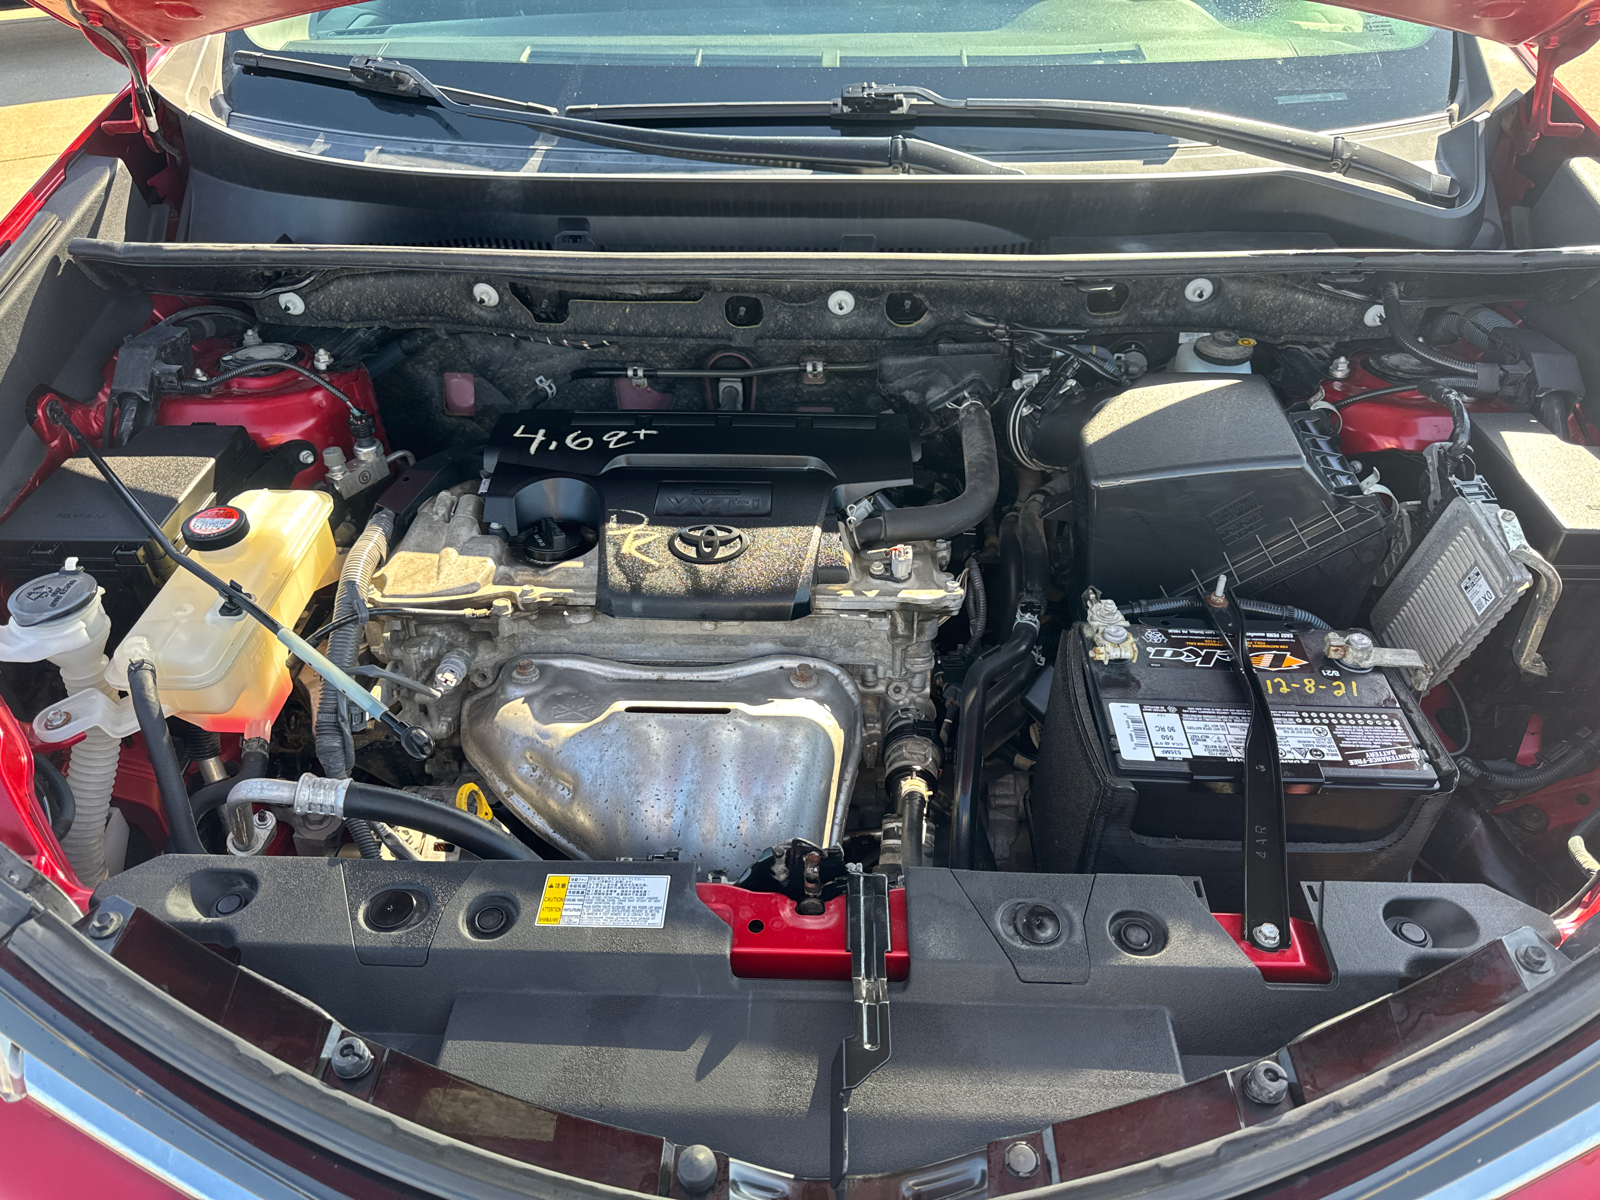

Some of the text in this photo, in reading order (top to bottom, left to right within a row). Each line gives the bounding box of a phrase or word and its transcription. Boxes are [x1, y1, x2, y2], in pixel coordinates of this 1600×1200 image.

[1266, 678, 1358, 696] 12-8-21
[1348, 753, 1418, 765] MAINTENANCE-FREE
[1366, 750, 1396, 758] BATTERY
